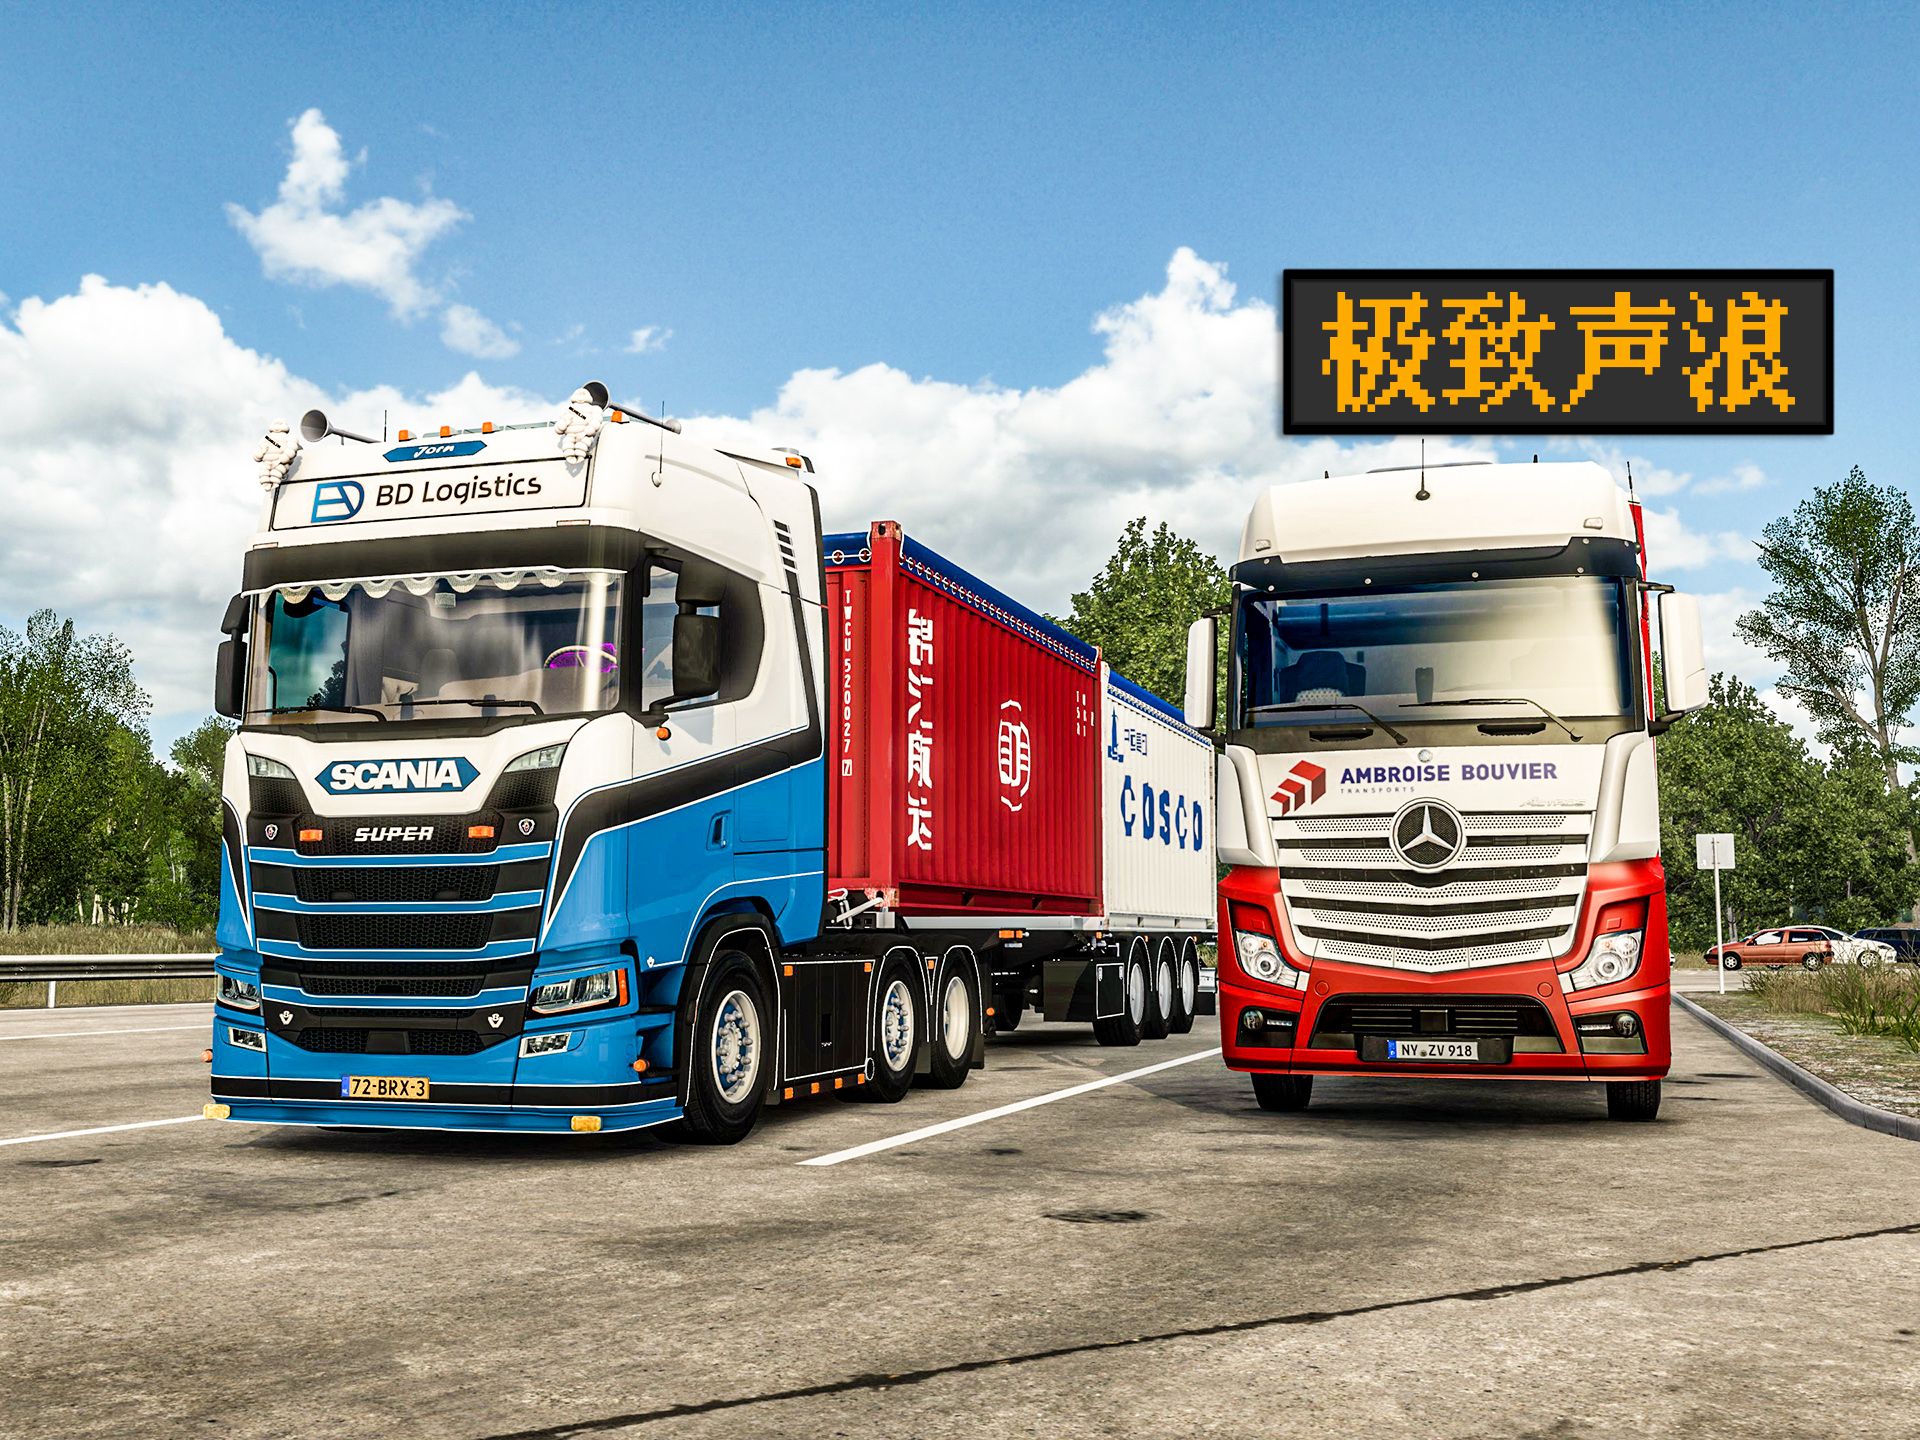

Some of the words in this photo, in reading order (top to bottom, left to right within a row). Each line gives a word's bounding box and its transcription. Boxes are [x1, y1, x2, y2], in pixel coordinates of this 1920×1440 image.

[375, 484, 414, 507] BD
[422, 472, 542, 505] Logistics
[329, 759, 463, 792] SCANIA
[1340, 765, 1450, 785] AMBROISE
[1461, 763, 1558, 781] BOUVIER
[1340, 786, 1416, 794] TRANSPORTS
[354, 826, 435, 843] SUPER
[1401, 1044, 1418, 1056] NY
[1428, 1044, 1445, 1056] ZV
[1448, 1045, 1472, 1057] 918
[352, 1079, 425, 1097] 72-BRX-3
